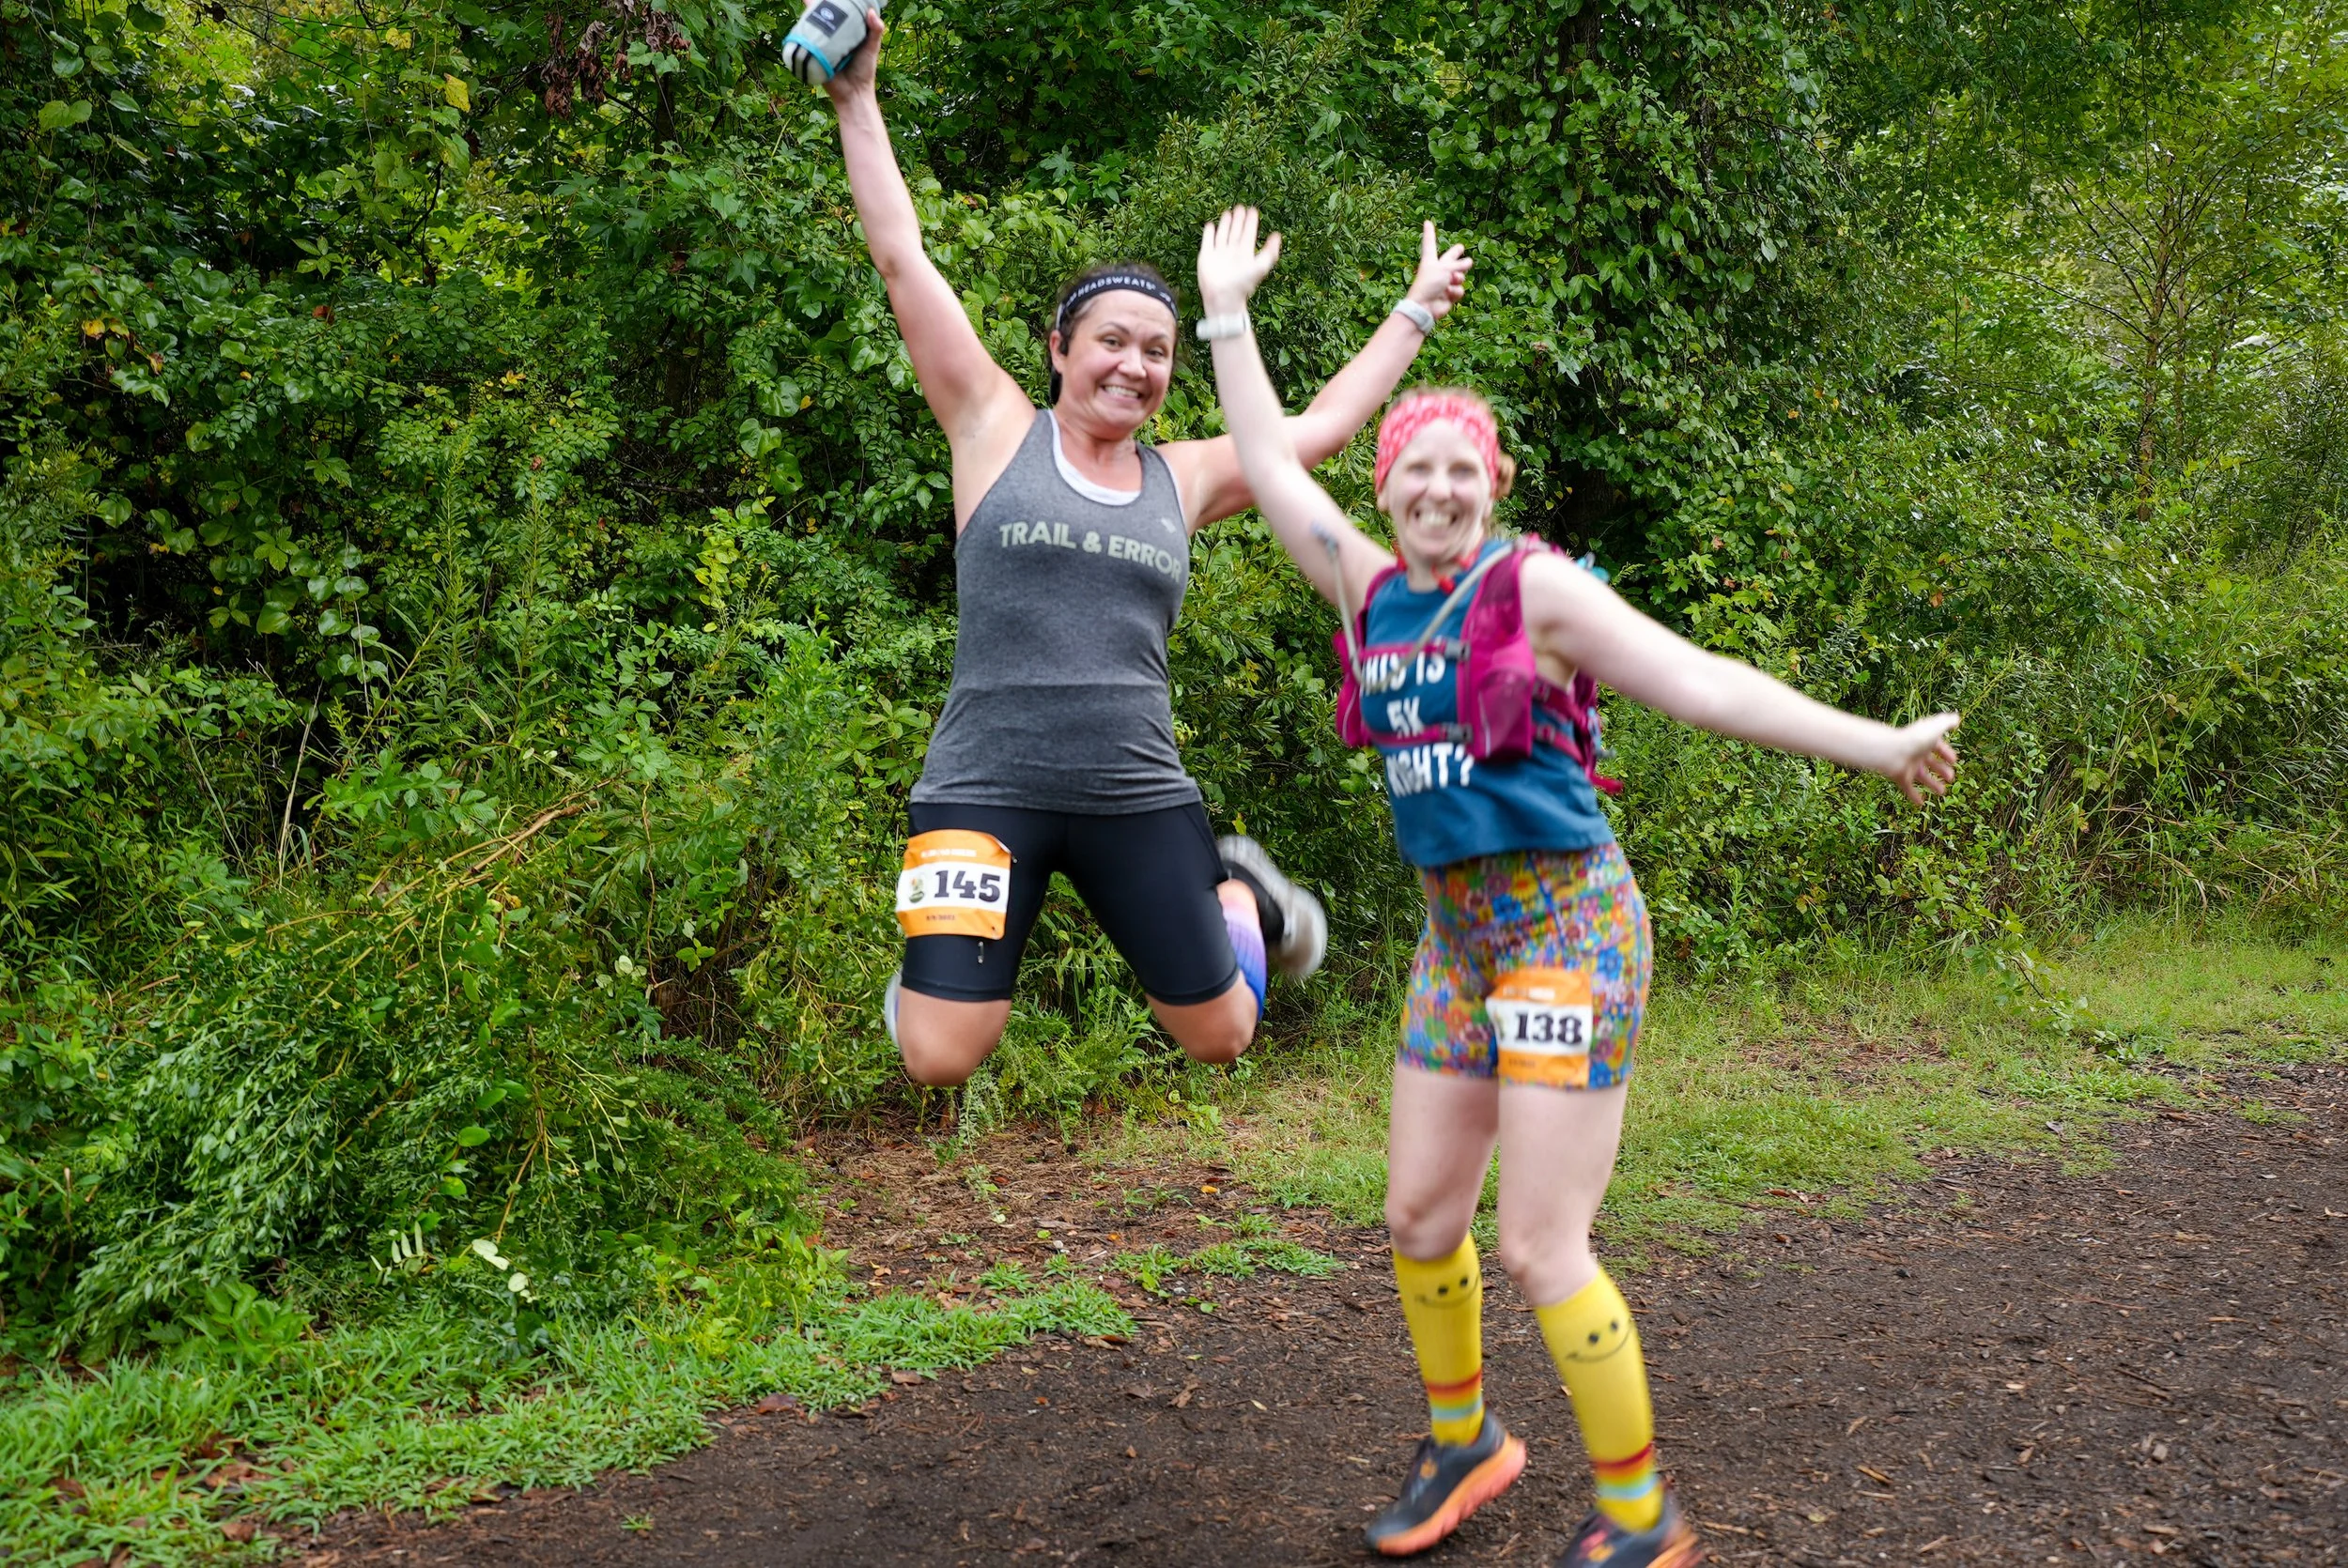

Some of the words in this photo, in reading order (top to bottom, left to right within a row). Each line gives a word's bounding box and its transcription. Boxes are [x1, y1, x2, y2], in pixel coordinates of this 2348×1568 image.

[1077, 276, 1153, 297] HEADSWEATS
[999, 521, 1076, 548] TRAIL
[1082, 531, 1102, 553] &
[1107, 535, 1182, 582] ERROR
[1361, 653, 1407, 694] HIS
[1415, 652, 1446, 685] IS
[1386, 697, 1424, 738] 5K
[934, 869, 1001, 902] 145
[1515, 1011, 1583, 1045] 138
